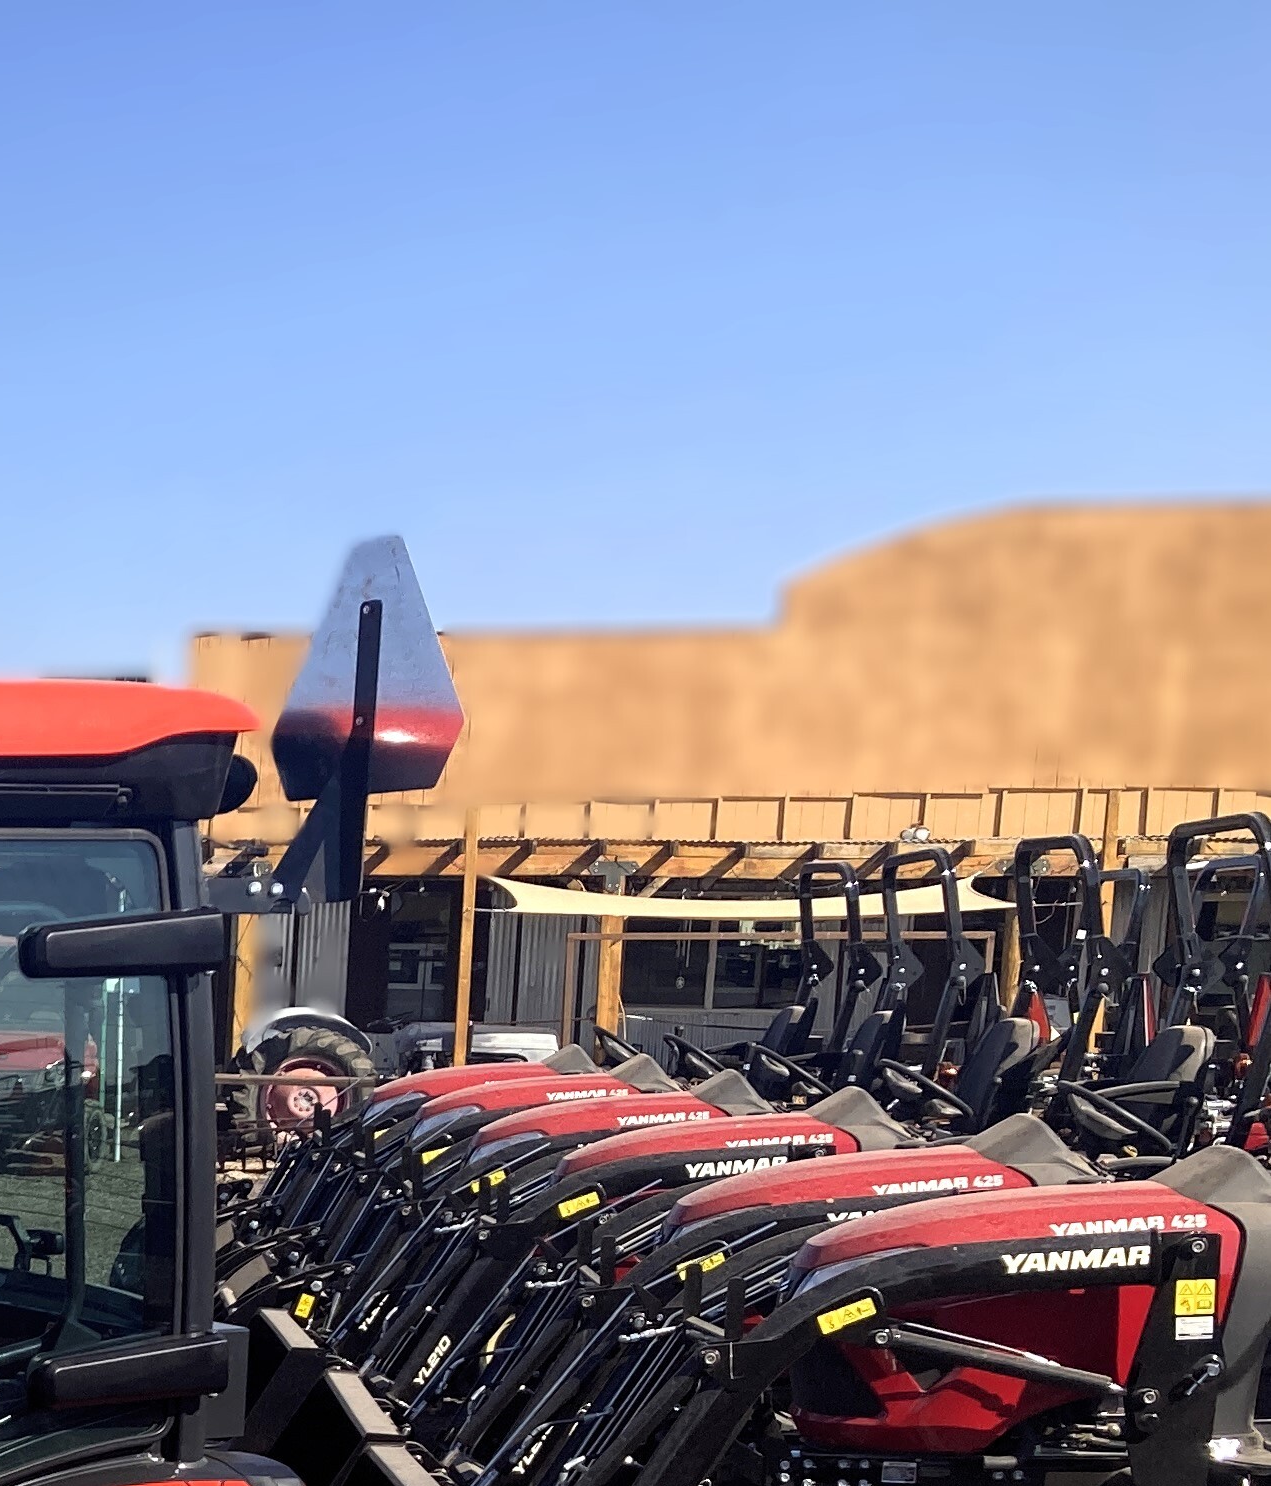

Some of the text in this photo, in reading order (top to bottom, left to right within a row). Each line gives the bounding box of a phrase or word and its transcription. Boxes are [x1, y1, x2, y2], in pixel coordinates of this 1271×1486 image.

[546, 1088, 607, 1101] YANMAR
[616, 1111, 687, 1126] YANMAR
[725, 1133, 834, 1148] YANMAR 425
[685, 1156, 789, 1179] YANMAR
[872, 1174, 1004, 1195] YANMAR 425
[1049, 1213, 1208, 1236] YANMAR 425
[1001, 1245, 1151, 1275] YANMAR
[413, 1335, 452, 1385] YL210
